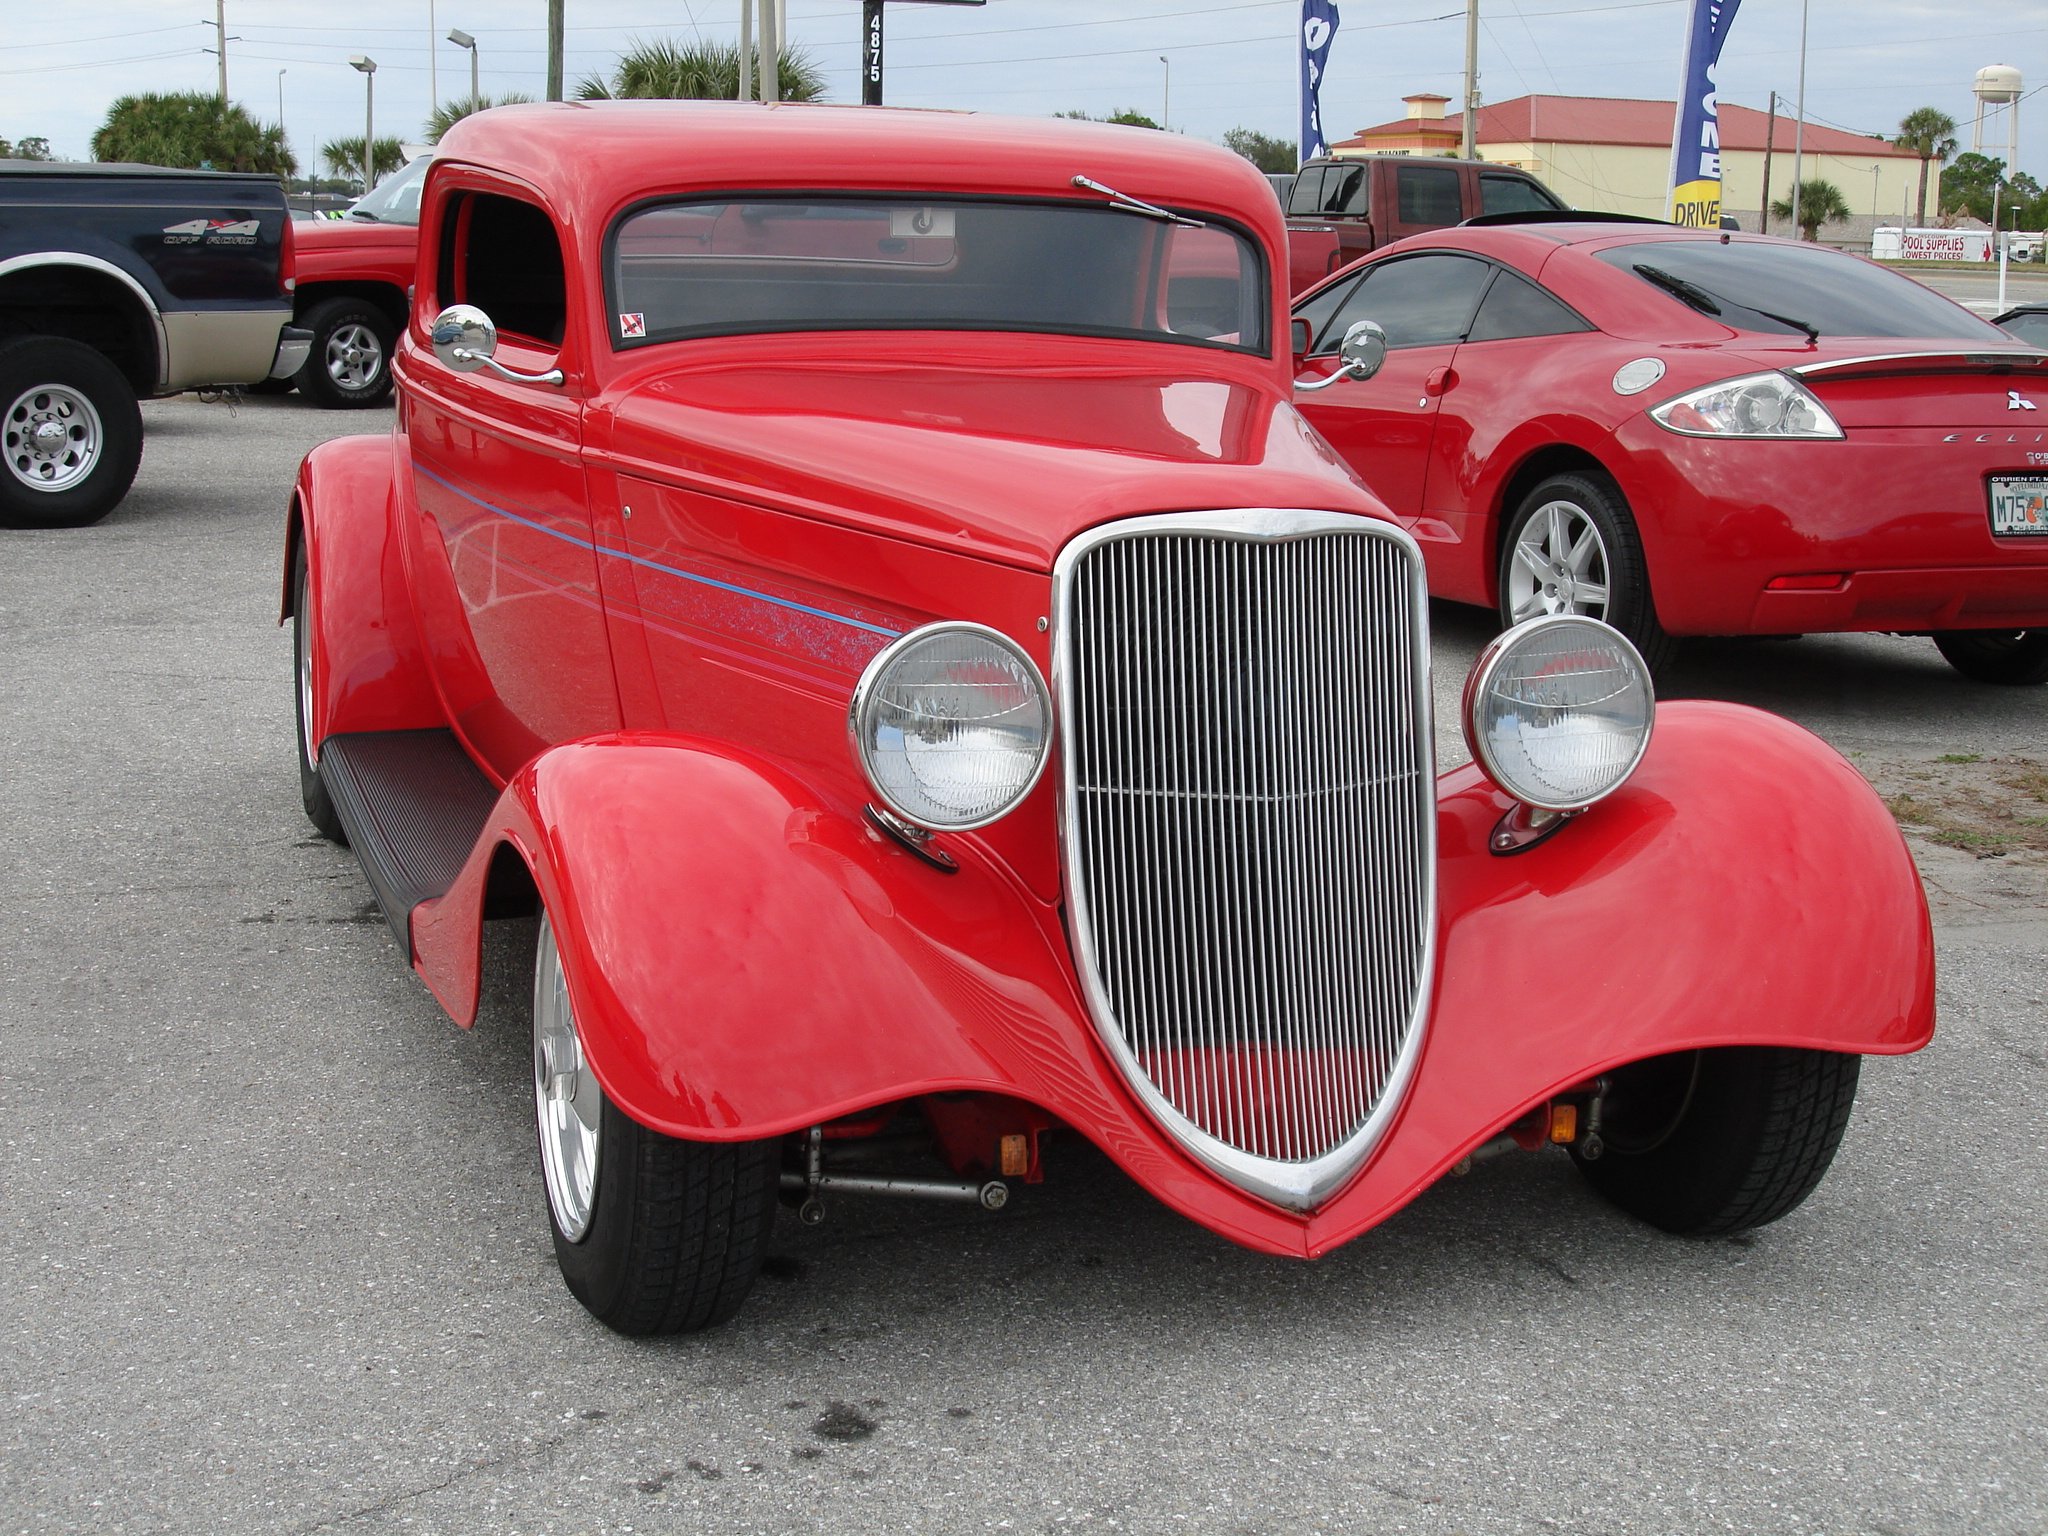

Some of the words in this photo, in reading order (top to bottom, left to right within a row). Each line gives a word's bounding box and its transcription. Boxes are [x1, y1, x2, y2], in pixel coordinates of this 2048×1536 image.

[870, 14, 881, 82] 4875
[1675, 201, 1720, 227] DRIVE
[163, 236, 201, 245] OFF
[206, 236, 258, 245] ROAD
[1903, 235, 1924, 250] POOL
[1926, 237, 1964, 251] SUPPLIES
[1902, 251, 1932, 259] LOWEST
[1933, 252, 1963, 260] PRICES!
[1996, 495, 2026, 522] M75
